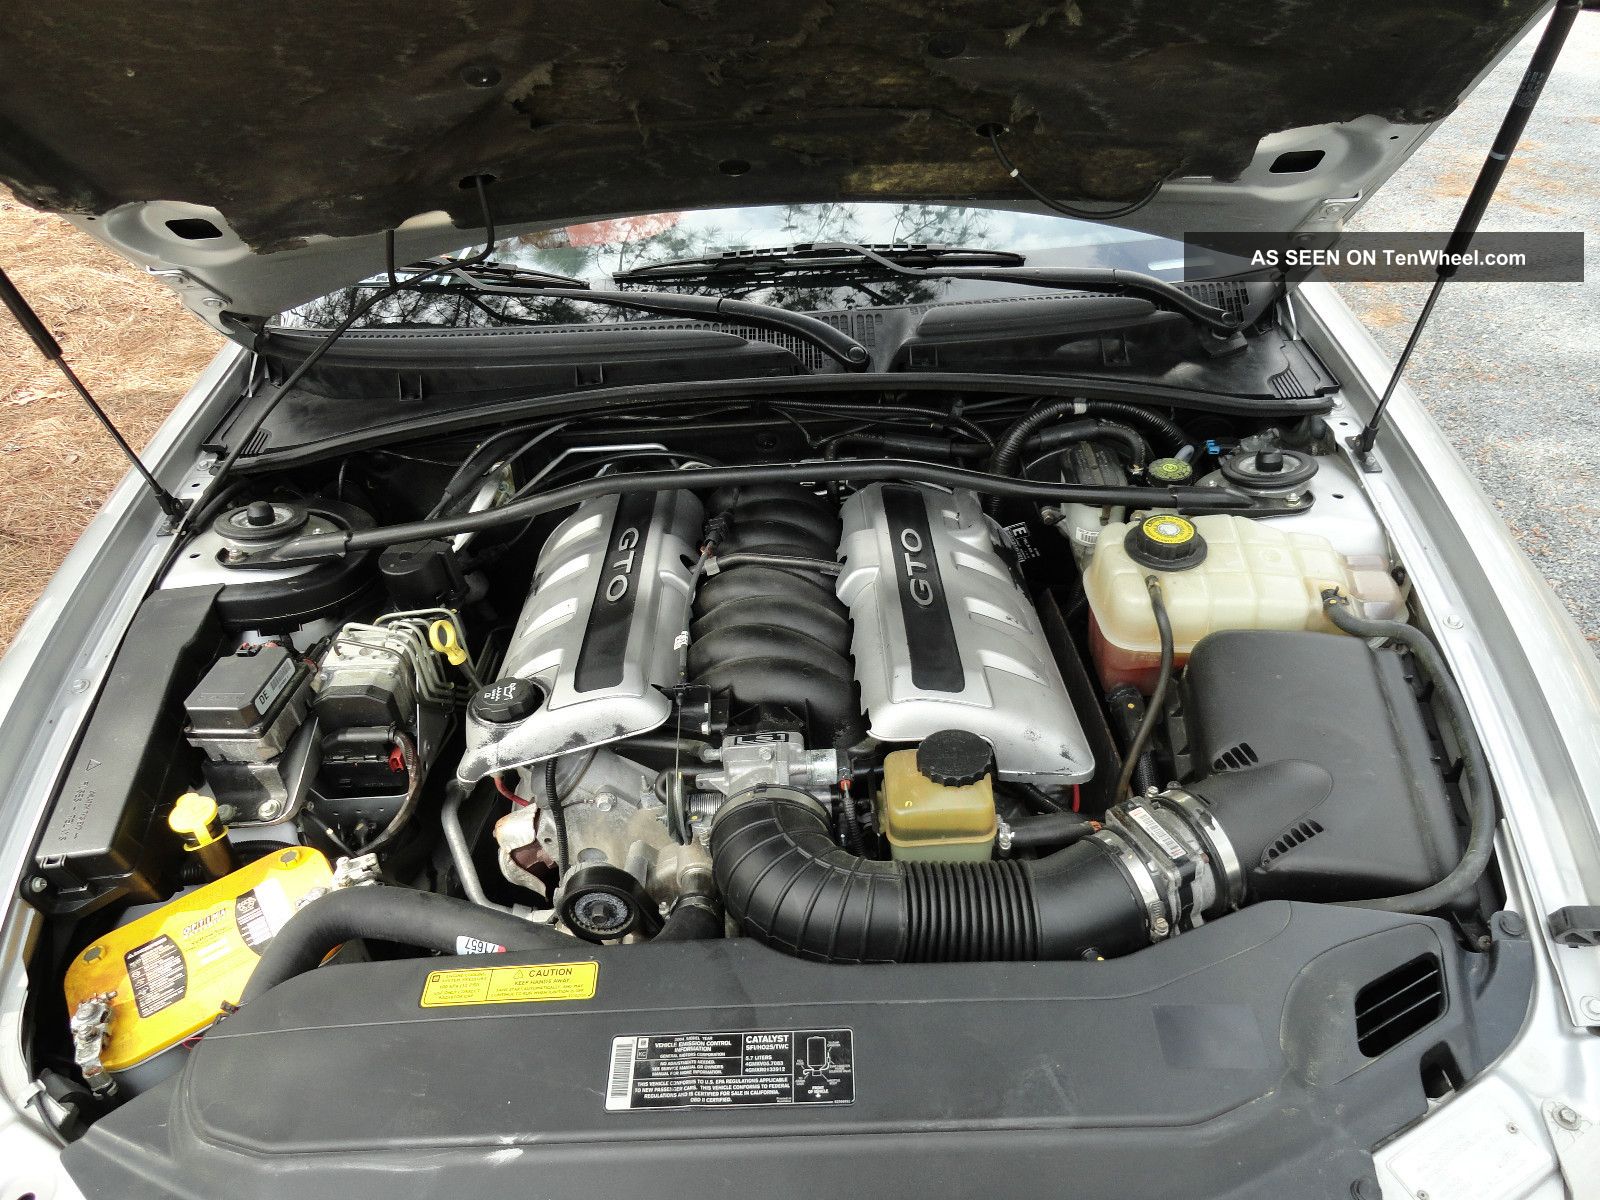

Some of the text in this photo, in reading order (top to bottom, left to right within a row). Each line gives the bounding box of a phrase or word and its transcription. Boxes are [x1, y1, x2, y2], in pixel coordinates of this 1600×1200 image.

[606, 527, 640, 602] GTO
[900, 528, 934, 606] GTO
[258, 690, 270, 705] DE
[528, 968, 573, 978] CAUTION
[746, 1035, 789, 1043] CATALYST
